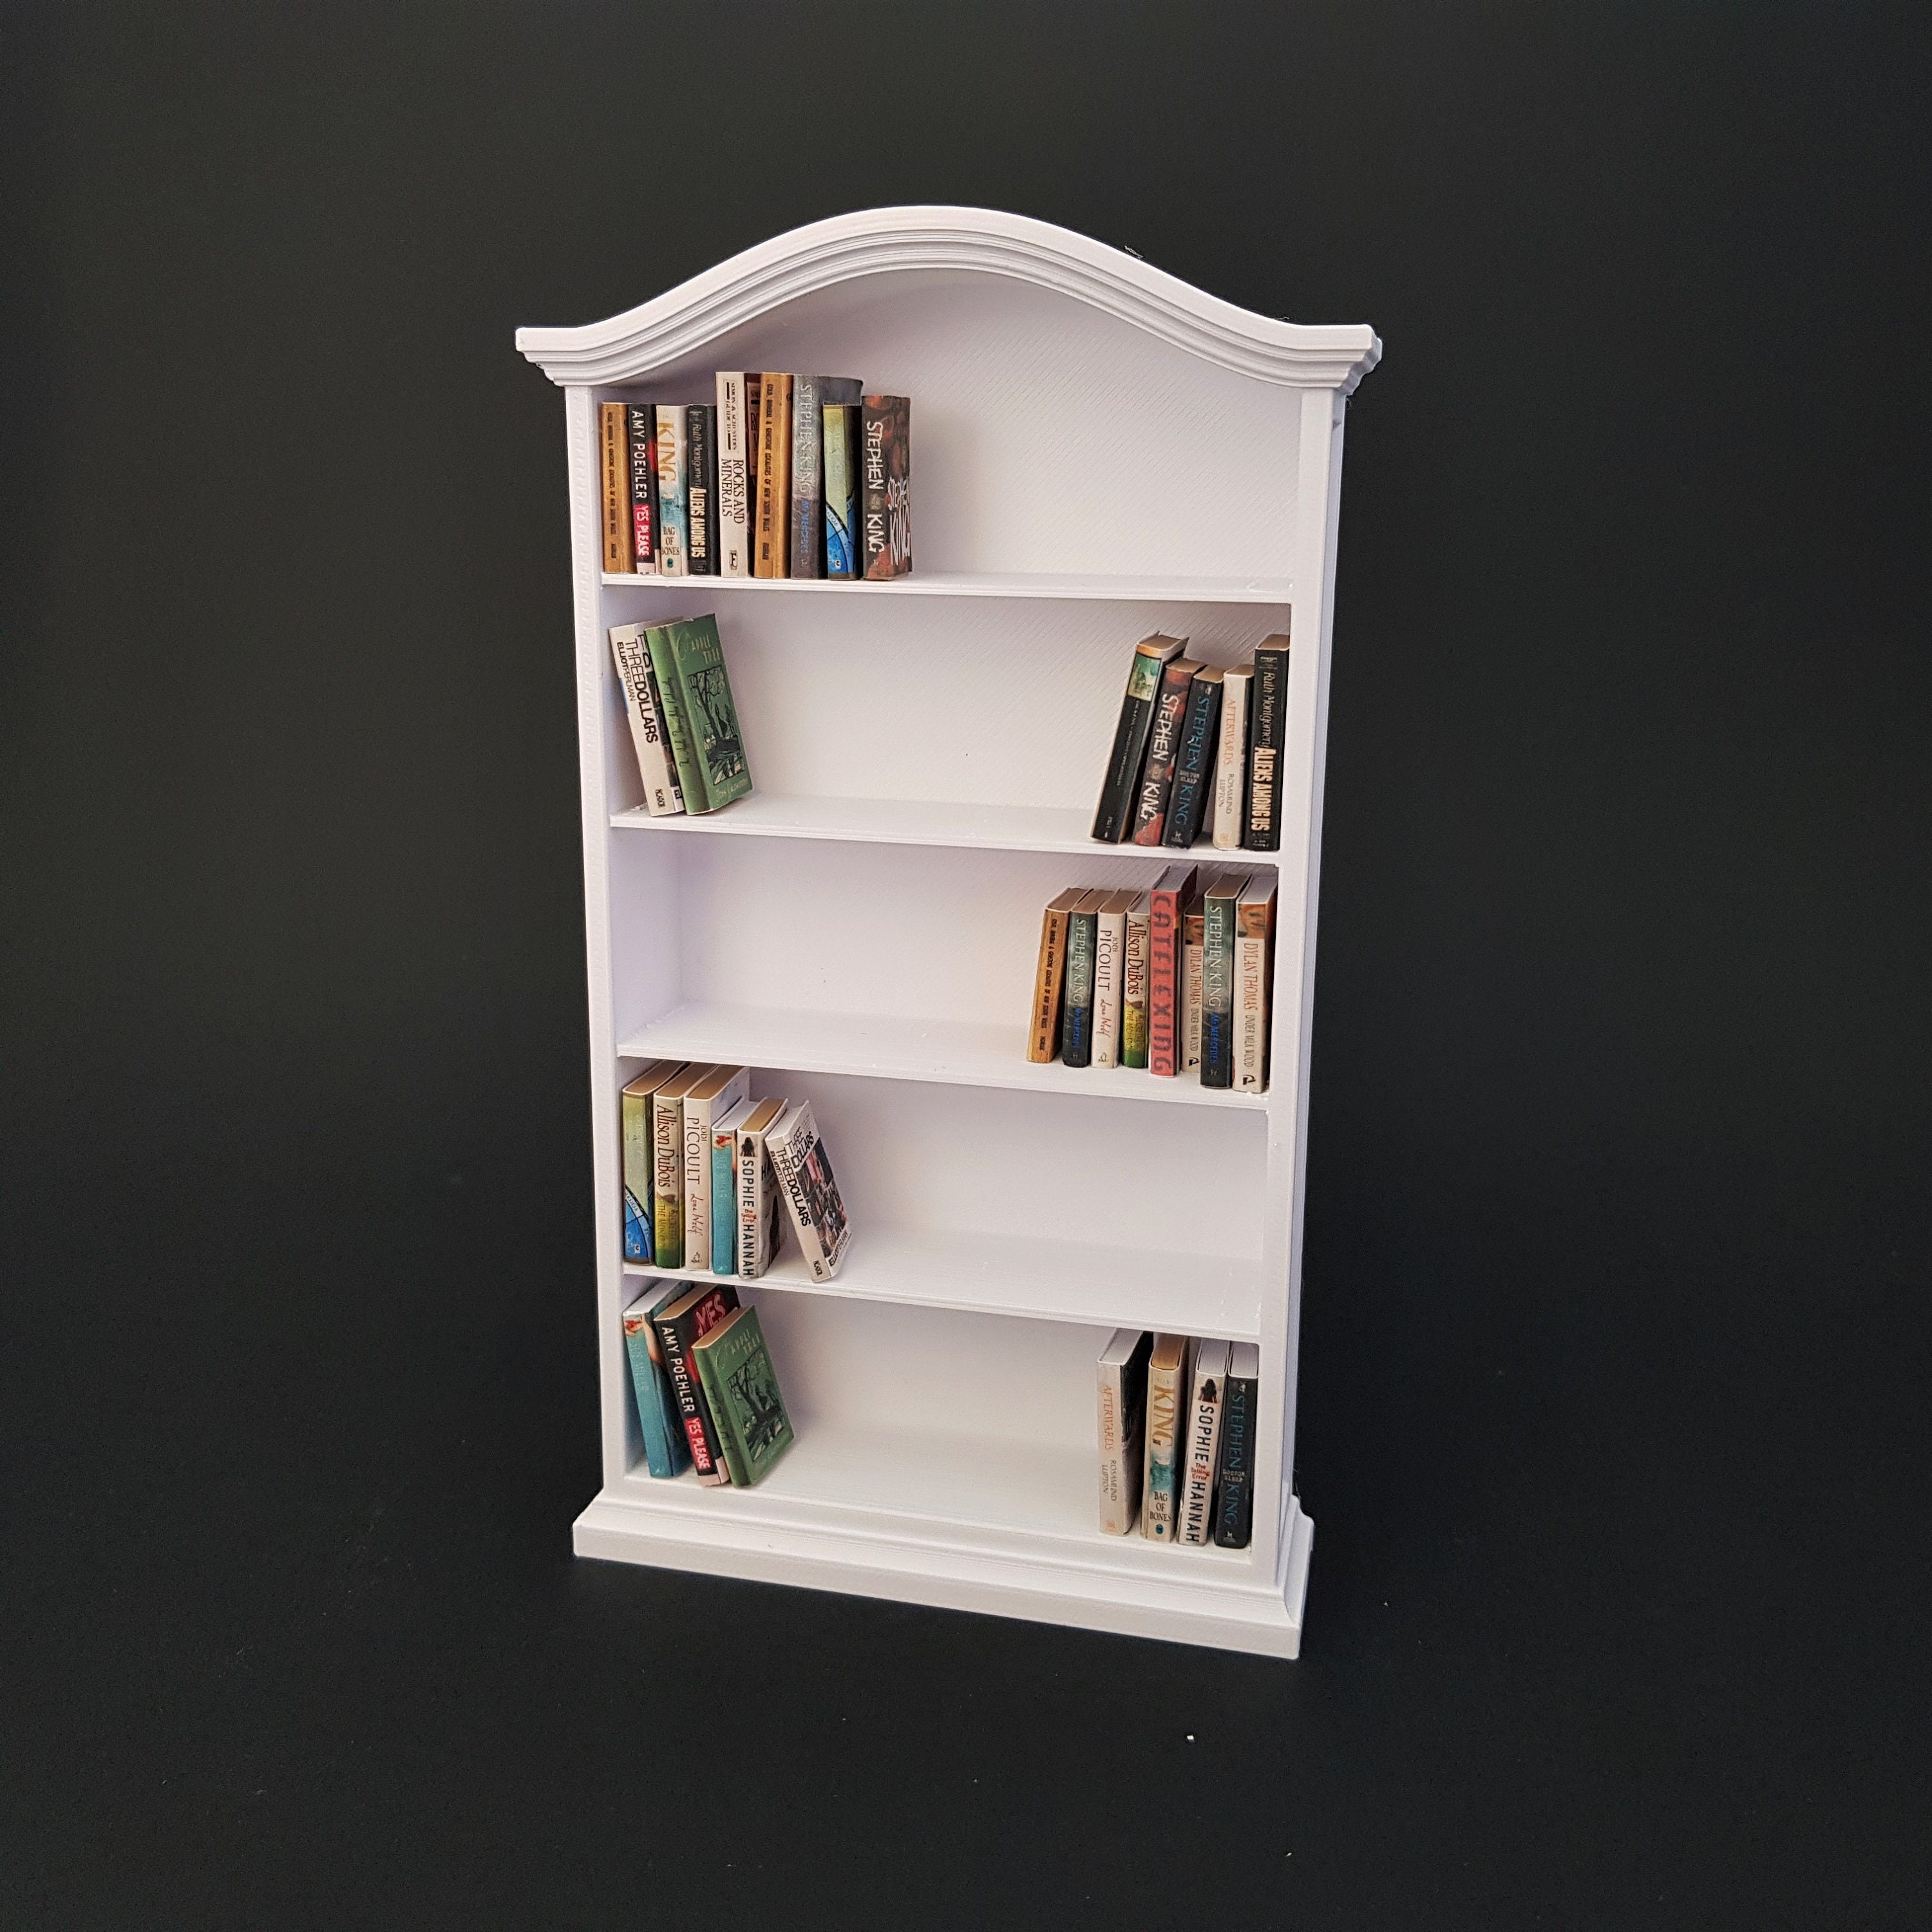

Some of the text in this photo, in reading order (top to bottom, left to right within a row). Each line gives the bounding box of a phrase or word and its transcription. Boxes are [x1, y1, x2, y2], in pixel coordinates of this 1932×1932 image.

[632, 411, 647, 498] AMY POEHLER
[658, 422, 676, 482] KING
[799, 384, 815, 493] STEPHEN KING
[690, 487, 707, 516] ALIENS
[721, 459, 732, 516] MINERALS
[733, 459, 744, 524] ROCKS AND
[867, 421, 885, 553] STEPHEN KING
[636, 506, 650, 556] YES PLEASE
[663, 527, 675, 535] BAG
[665, 536, 674, 545] OF
[690, 516, 706, 545] AMONG
[691, 546, 706, 558] US
[1187, 696, 1210, 772] STEPHEN
[1224, 699, 1236, 766] AFTERWARDS
[1258, 697, 1276, 748] Montgomery
[1141, 694, 1179, 821] STEPHEN KING
[1254, 746, 1277, 782] ALIENS
[1175, 785, 1193, 826] KING
[1251, 816, 1271, 831] US
[1253, 784, 1272, 815] AMONG
[1073, 919, 1087, 1002] STEPHEN KING
[1097, 930, 1112, 991] PICOULT
[1128, 920, 1146, 956] Allison
[1190, 949, 1202, 972] DYLAN
[1208, 905, 1222, 1007] STEPHEN KING
[1244, 943, 1258, 972] DYLAN
[1128, 958, 1144, 995] DuBois
[1189, 975, 1201, 1005] THOMAS
[1243, 975, 1258, 1010] THOMAS
[1245, 1015, 1256, 1034] UNDER
[1244, 1049, 1254, 1067] WOOD
[657, 1104, 677, 1188] Allison DuBois
[687, 1117, 700, 1184] PICOULT
[742, 1160, 754, 1208] SOPHIE
[742, 1224, 755, 1276] HANNAH
[696, 1294, 726, 1332] YES
[662, 1327, 696, 1413] AMY POEHLER
[1102, 1385, 1116, 1451] AFTERWARDS
[1153, 1385, 1175, 1447] KING
[690, 1417, 712, 1470] YES PLEASE
[1225, 1395, 1245, 1525] STEPHEN KING
[1154, 1492, 1168, 1501] BAG
[1186, 1405, 1214, 1543] SOPHIE HANNAH
[1150, 1512, 1172, 1522] BONES
[1156, 1502, 1165, 1512] OF
